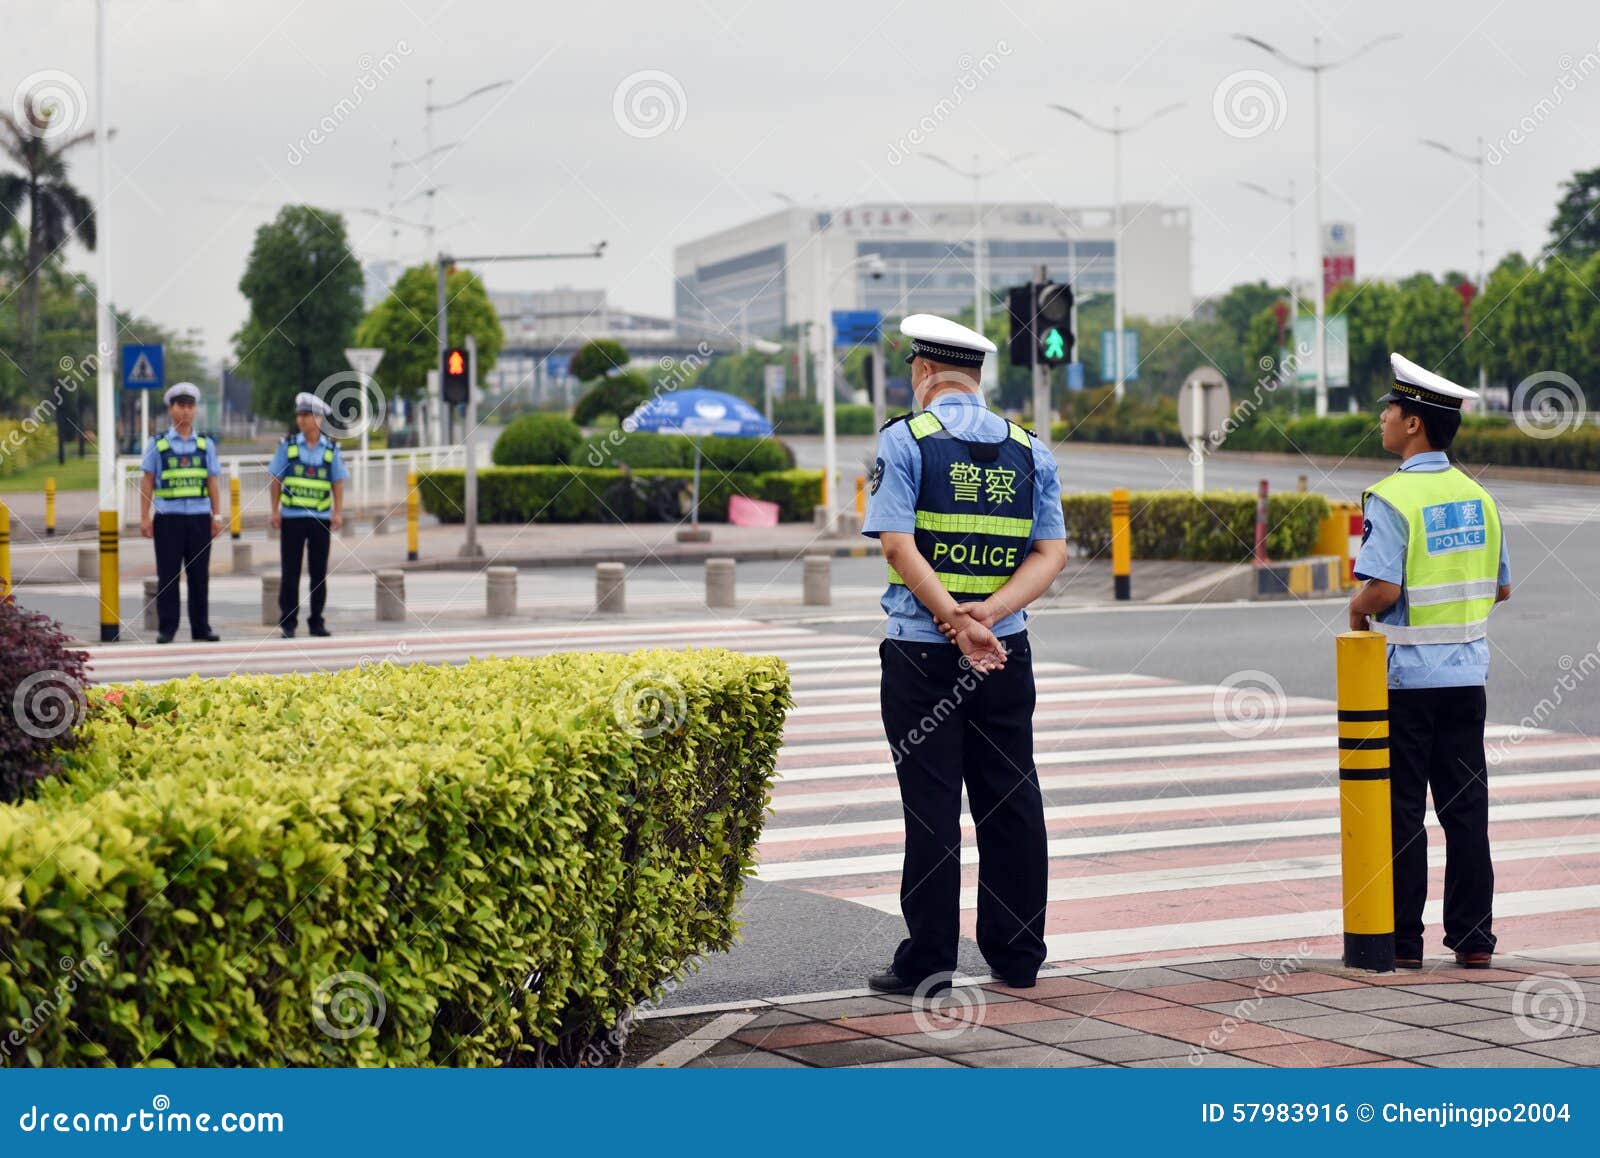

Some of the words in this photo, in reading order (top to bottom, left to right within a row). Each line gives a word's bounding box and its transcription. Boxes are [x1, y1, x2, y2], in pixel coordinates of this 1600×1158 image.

[949, 462, 1016, 504] 警察
[1431, 502, 1479, 530] 警察
[1435, 531, 1481, 549] POLICE
[933, 542, 1018, 568] POLICE
